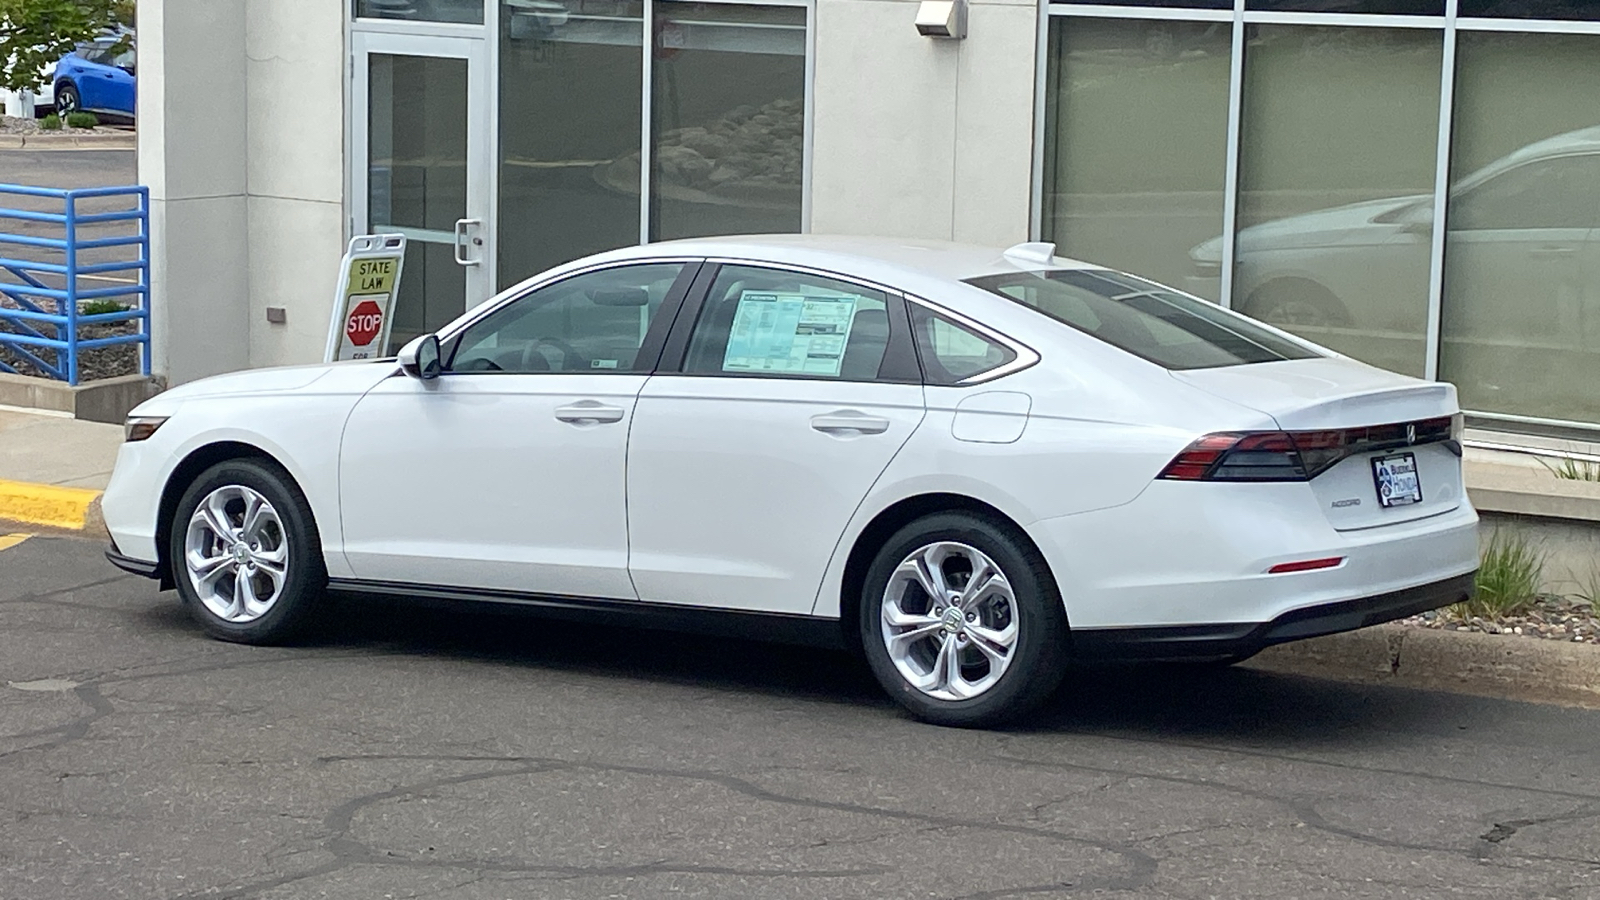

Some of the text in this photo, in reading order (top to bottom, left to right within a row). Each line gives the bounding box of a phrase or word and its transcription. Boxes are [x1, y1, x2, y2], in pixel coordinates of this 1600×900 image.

[360, 262, 391, 275] STATE
[361, 277, 384, 290] LAW
[347, 314, 382, 333] STOP
[1393, 475, 1418, 493] HONDA
